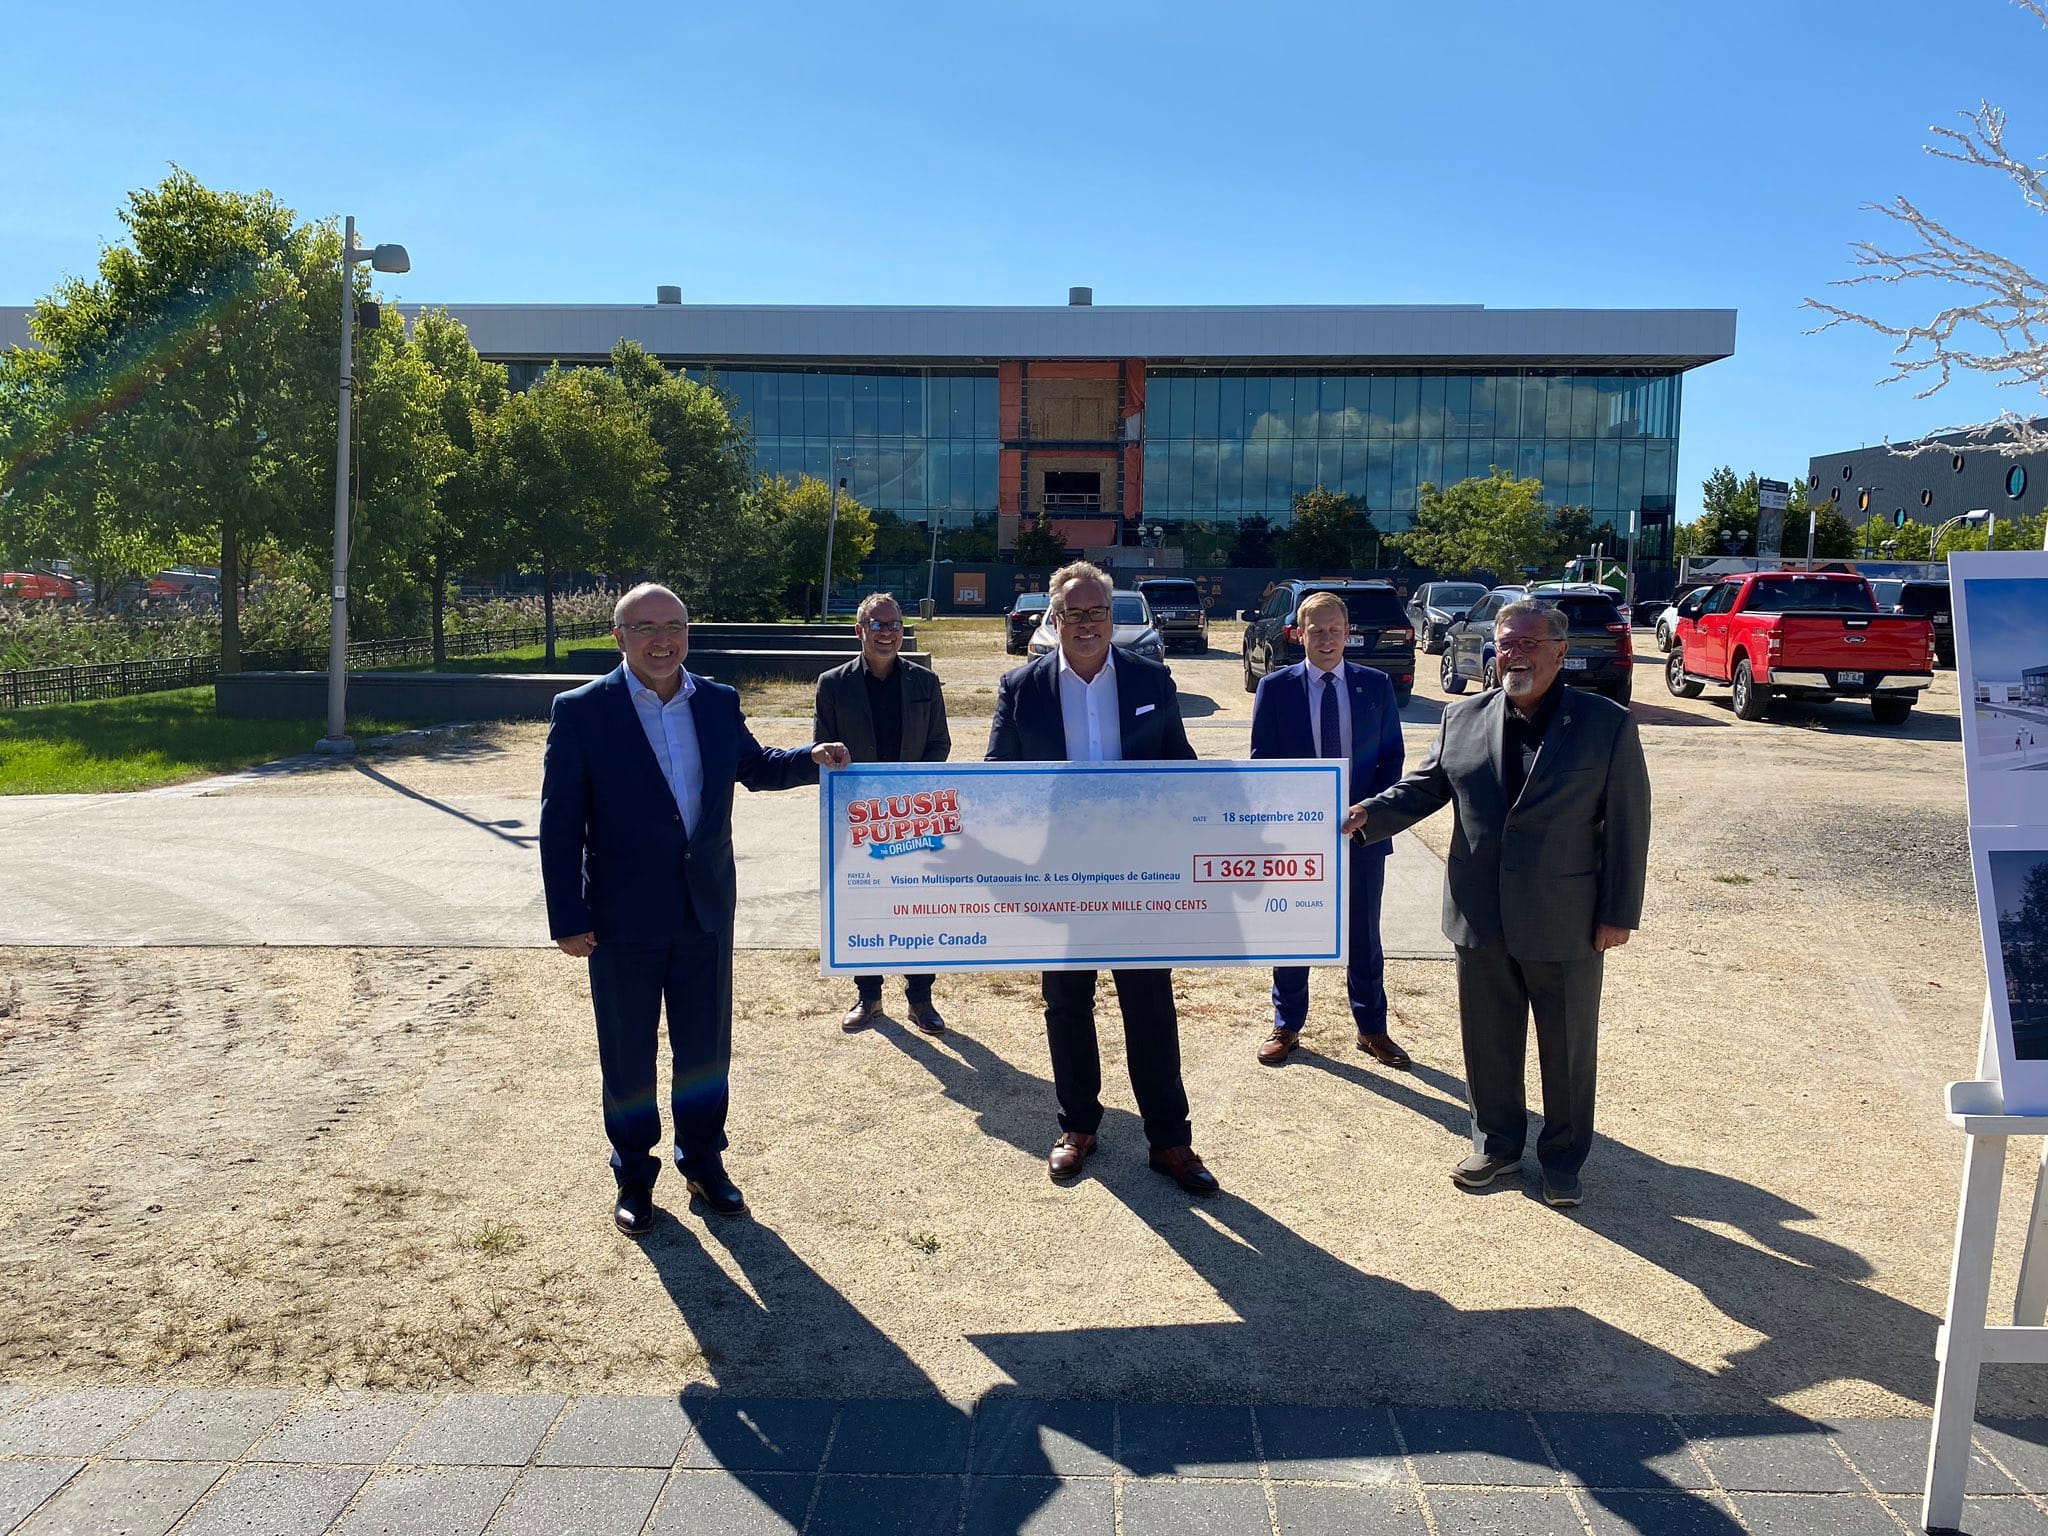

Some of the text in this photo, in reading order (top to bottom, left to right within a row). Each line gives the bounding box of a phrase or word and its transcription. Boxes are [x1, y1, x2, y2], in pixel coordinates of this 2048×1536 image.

[957, 590, 982, 601] JPL
[848, 789, 958, 823] SLUSH
[1222, 811, 1324, 824] 18 septembre 2020
[889, 837, 935, 855] ORIGINAL
[1203, 857, 1316, 878] 1 362 500 $
[890, 871, 1181, 886] Vision Multisports Outaouais Inc. & Les Olympiques de Gatineau
[893, 899, 1208, 915] UN MILLION TROIS CENT SOIXANTE-DEUX MILLE CINQ CENTS
[1264, 898, 1323, 912] /00 DOLLARS
[848, 932, 987, 949] Slush Puppie Canada
